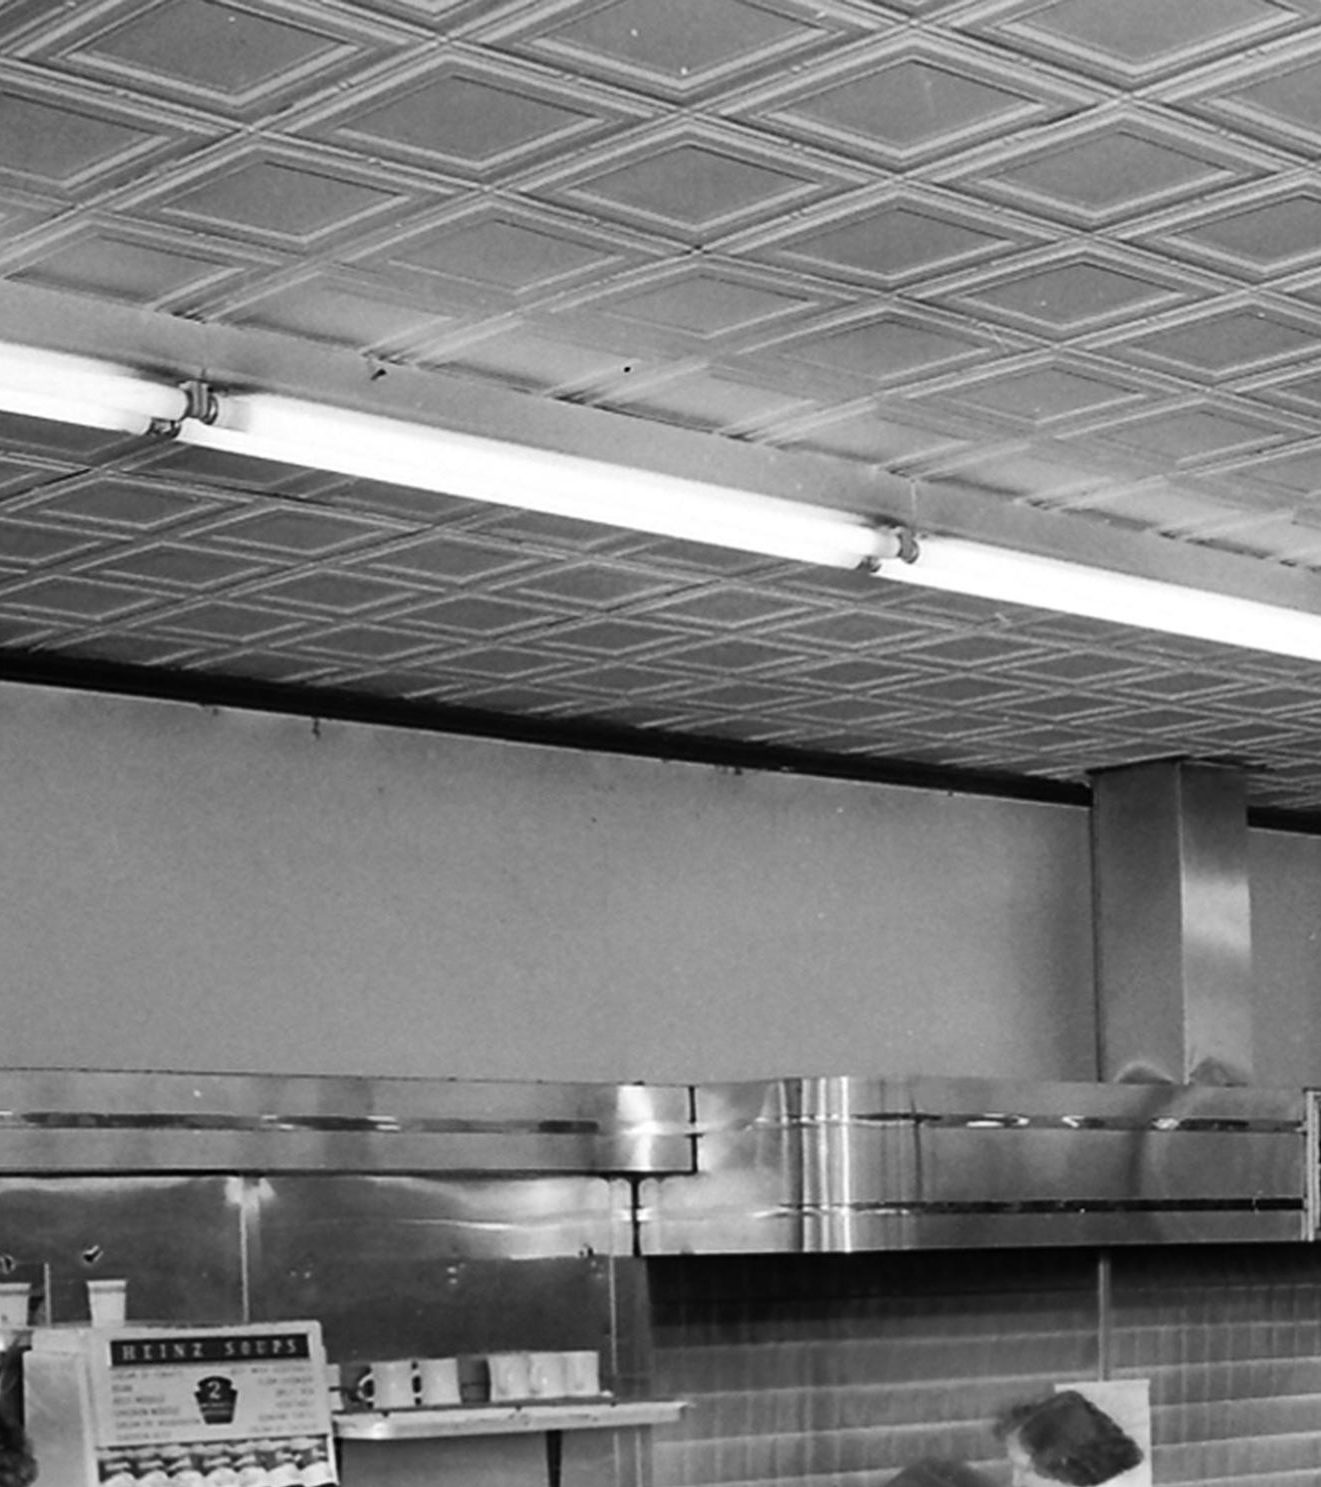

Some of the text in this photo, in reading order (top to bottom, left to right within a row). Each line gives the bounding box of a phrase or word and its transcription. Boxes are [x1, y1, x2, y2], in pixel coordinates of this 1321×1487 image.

[122, 1339, 297, 1360] HEINZ SOUPS
[207, 1381, 221, 1399] 2
